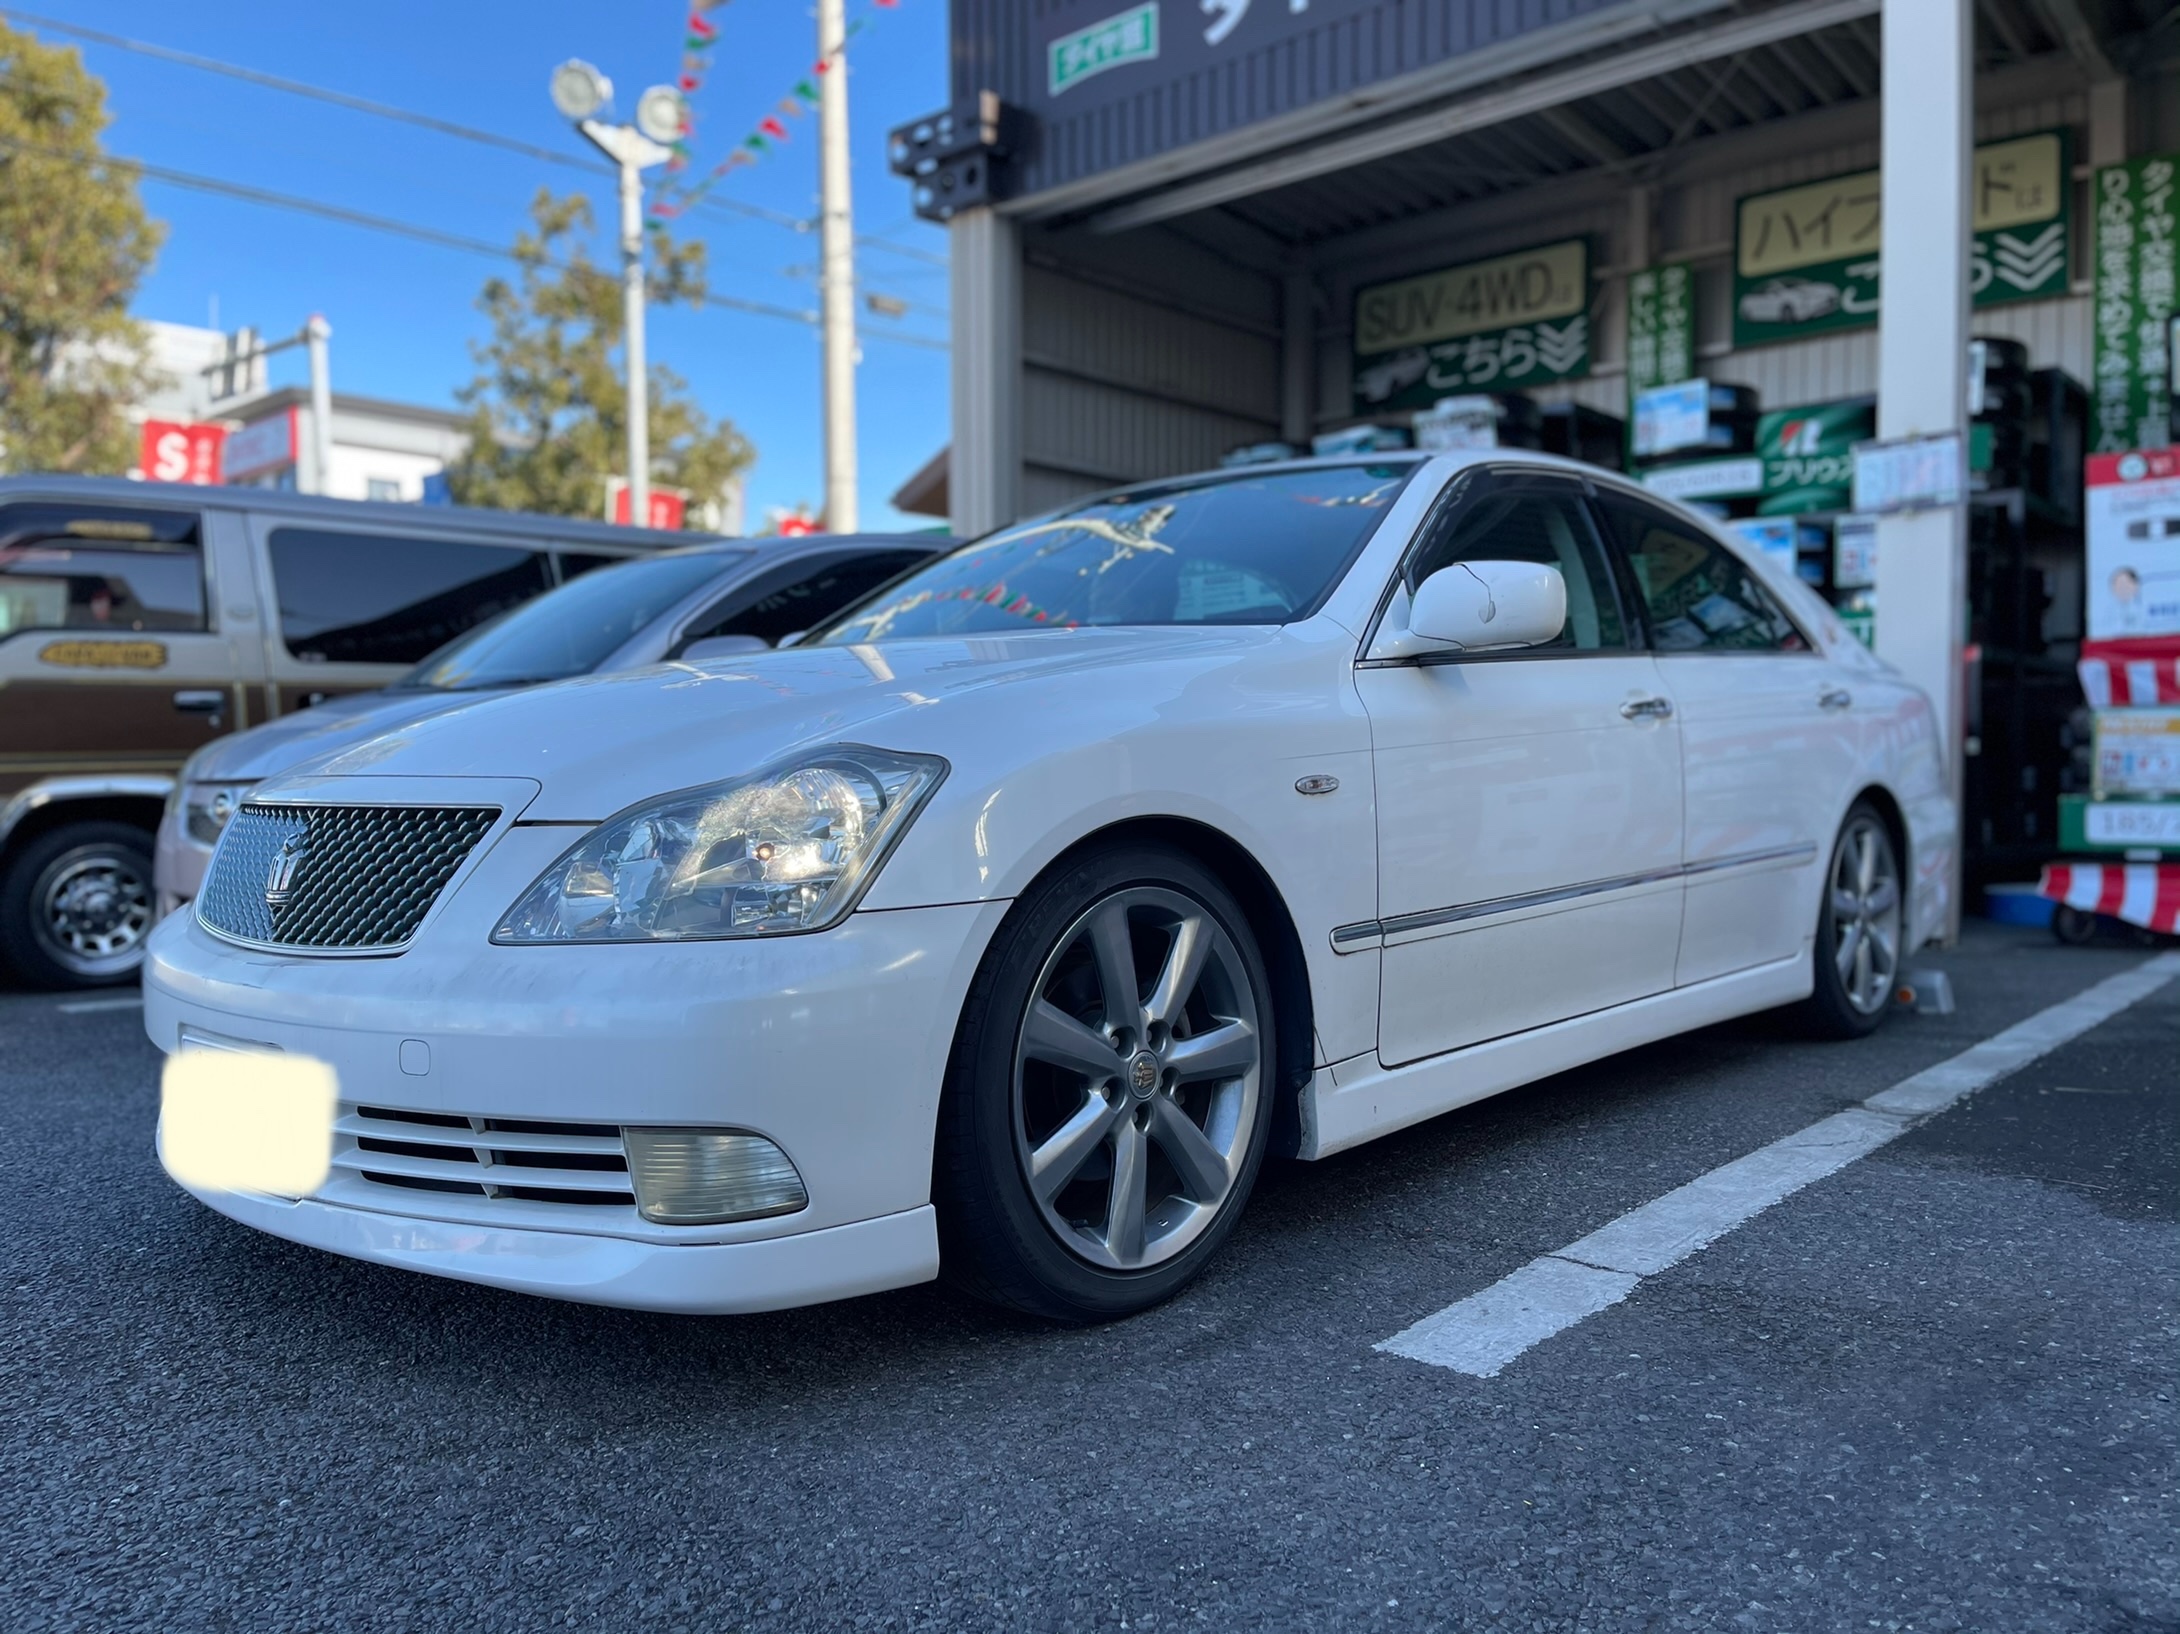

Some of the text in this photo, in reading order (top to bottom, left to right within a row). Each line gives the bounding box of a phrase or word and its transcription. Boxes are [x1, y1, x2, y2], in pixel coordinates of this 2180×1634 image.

[1751, 159, 2043, 261] ハイドは
[1426, 327, 1538, 389] こちら
